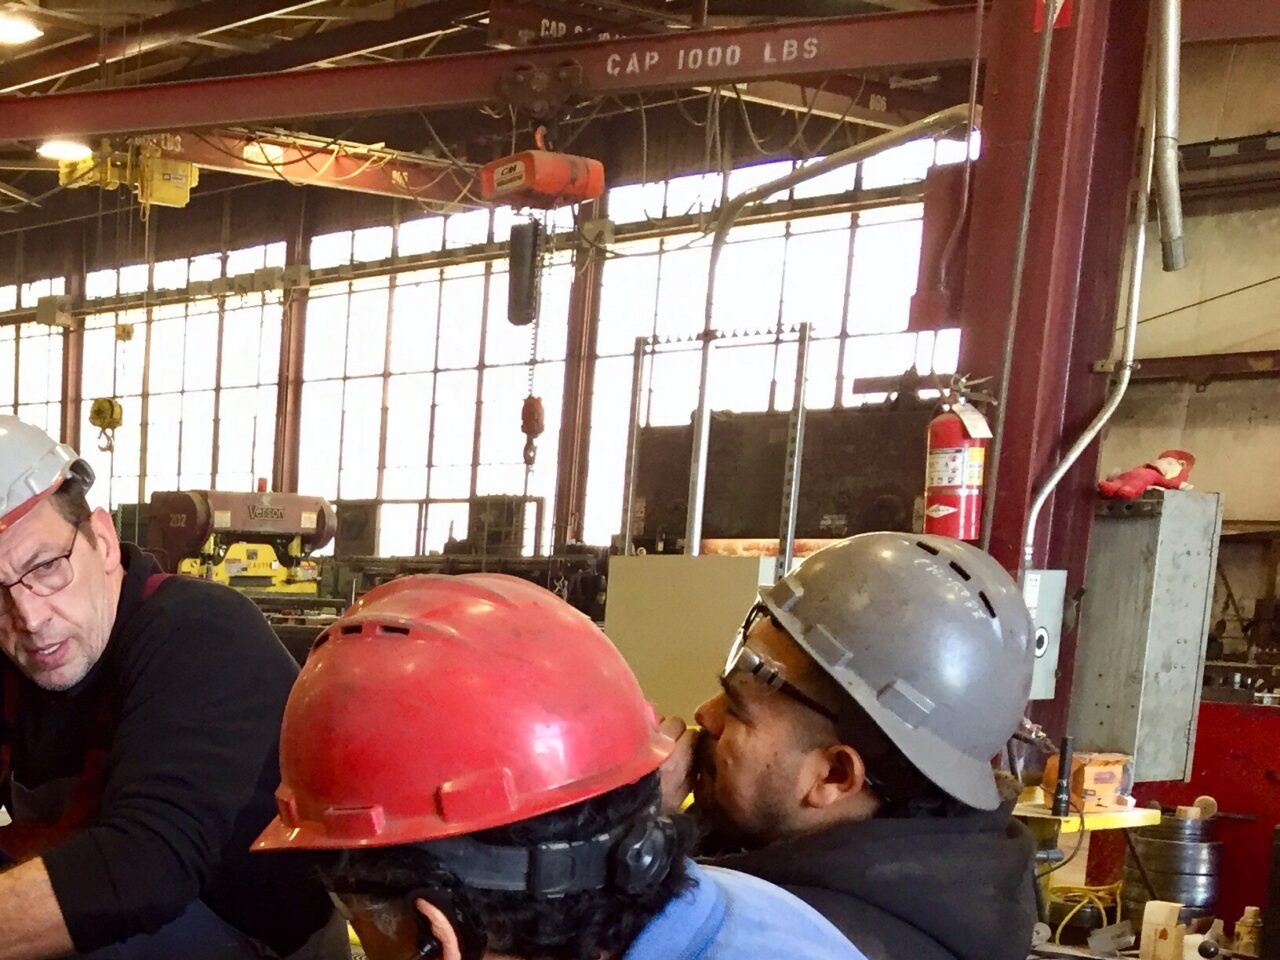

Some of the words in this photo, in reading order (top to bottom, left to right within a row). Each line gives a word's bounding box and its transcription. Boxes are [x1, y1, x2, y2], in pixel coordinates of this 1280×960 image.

[606, 51, 660, 77] CAP
[677, 44, 742, 70] 1000
[763, 37, 819, 63] LBS
